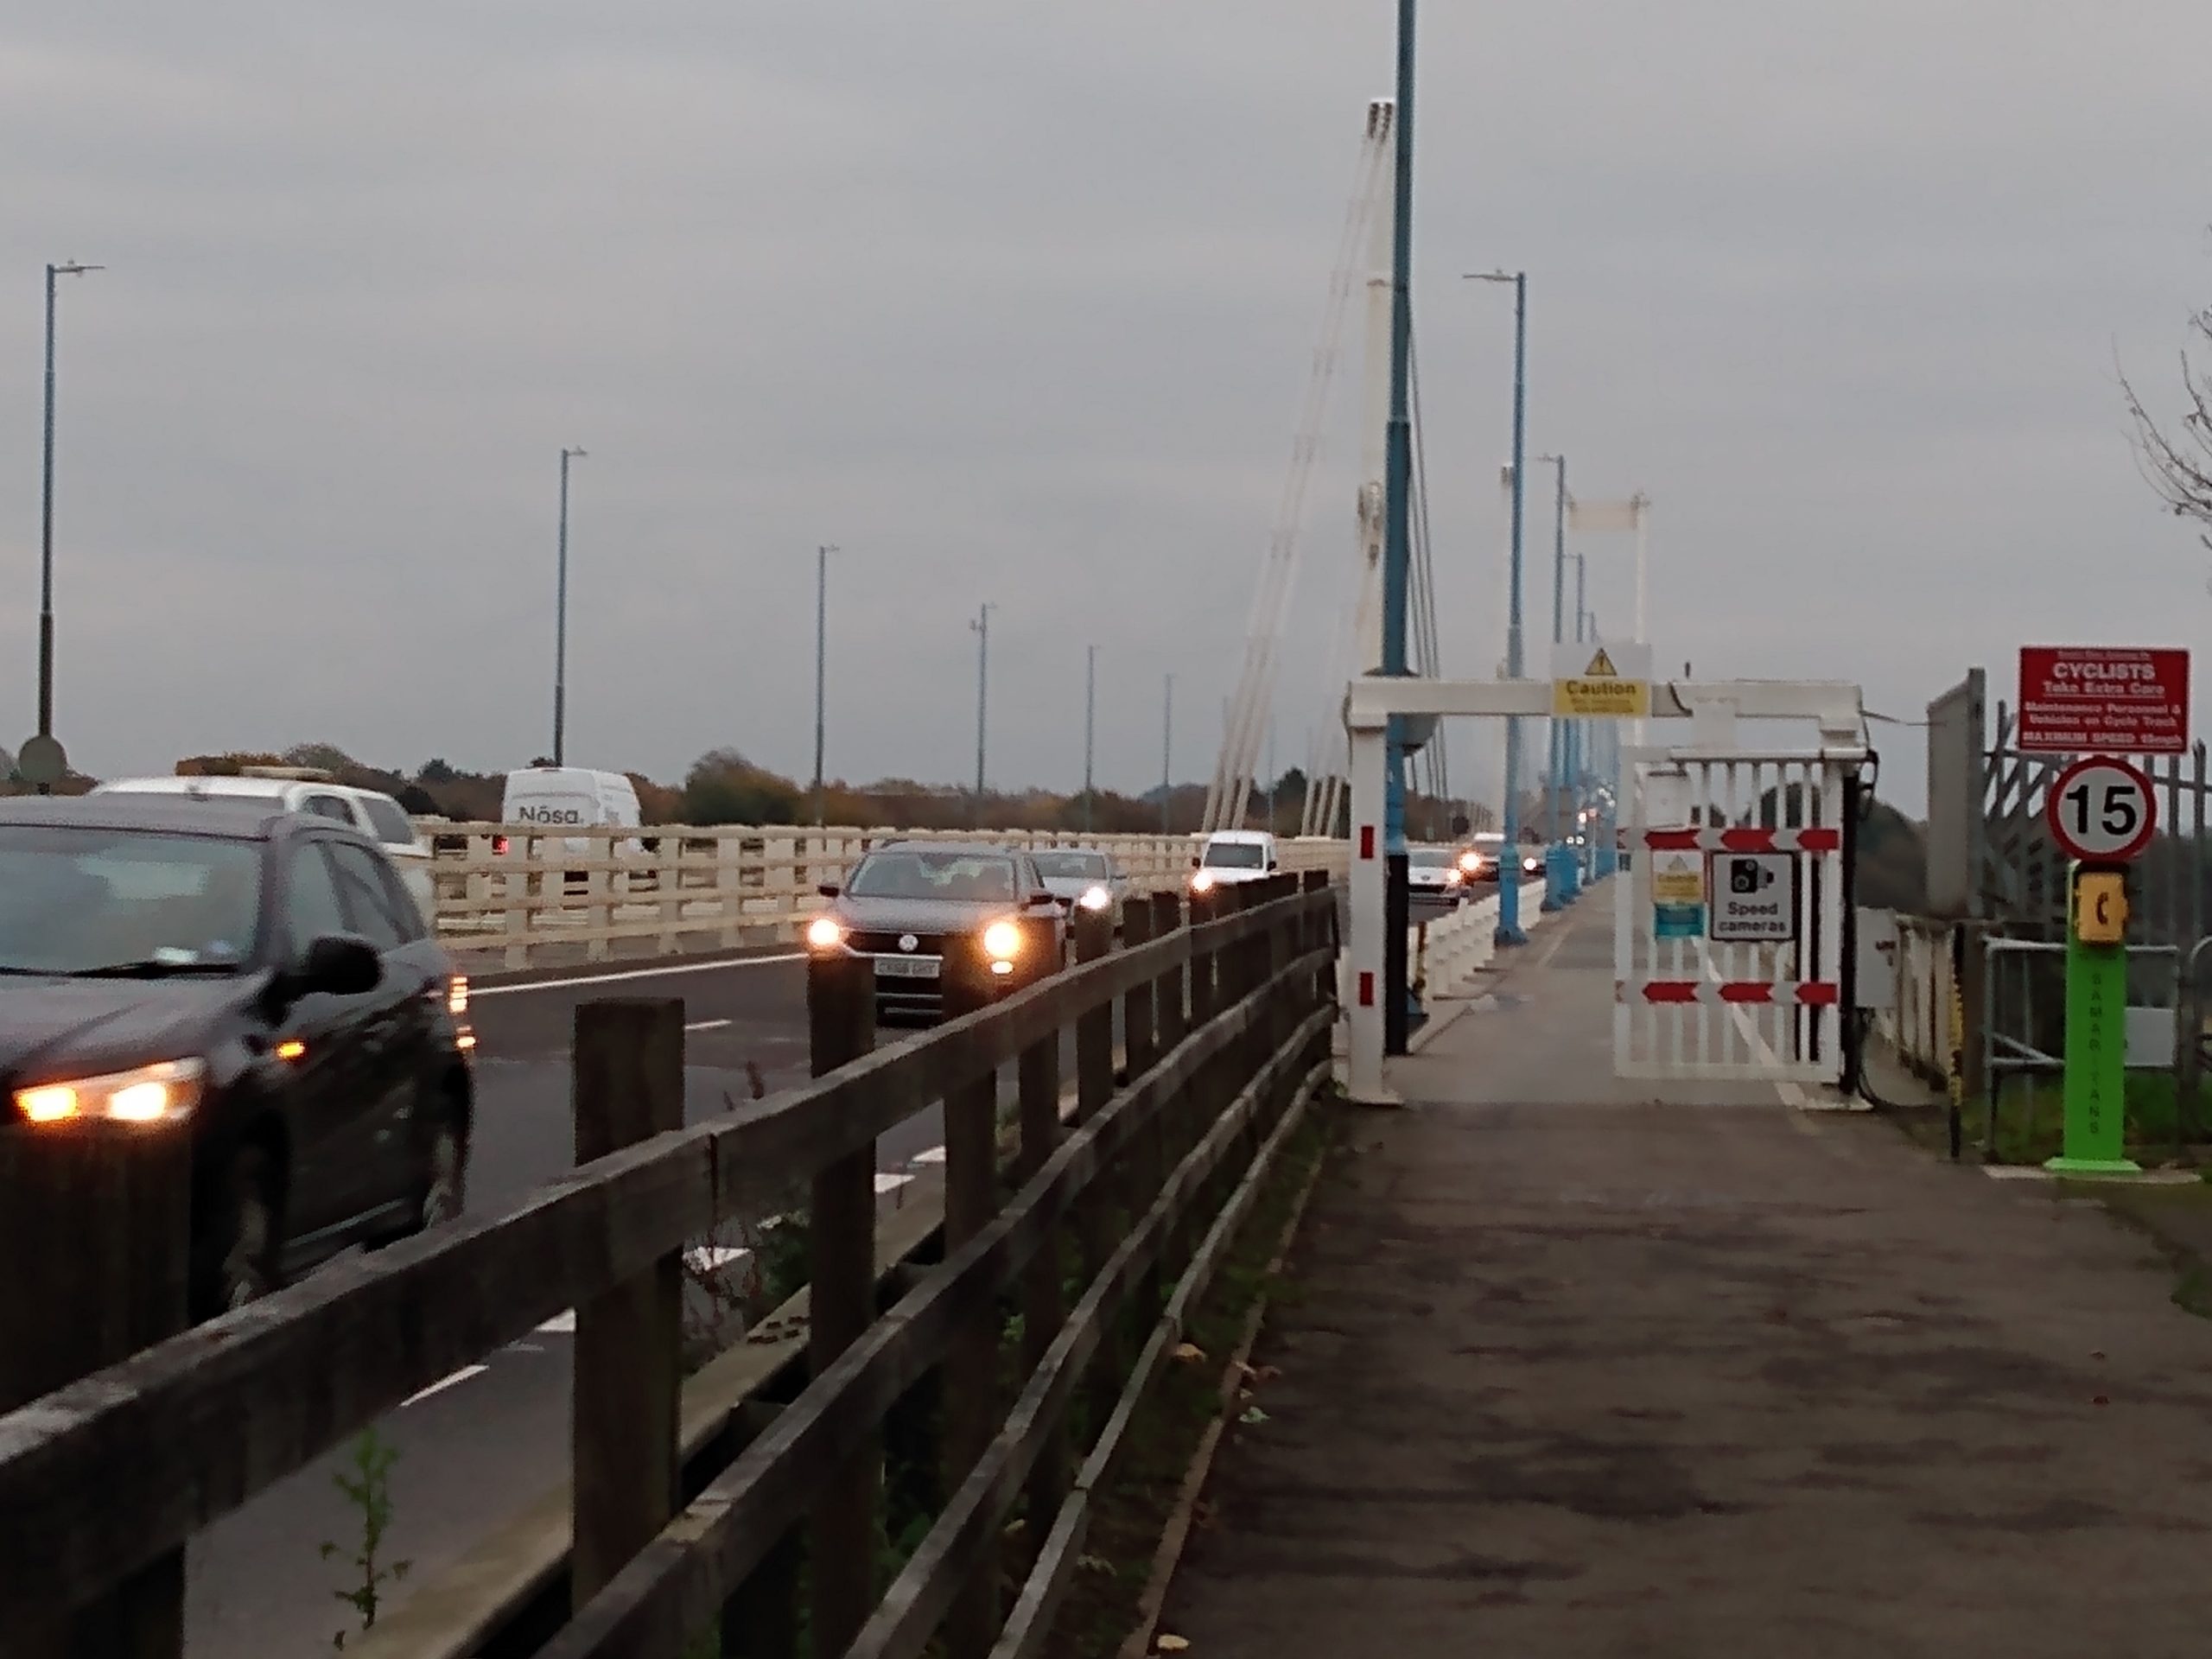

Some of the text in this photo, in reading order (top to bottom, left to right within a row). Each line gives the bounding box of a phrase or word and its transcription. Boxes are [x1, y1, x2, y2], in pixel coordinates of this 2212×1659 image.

[2053, 663, 2155, 679] CYCLISTS
[1566, 680, 1636, 695] Caution
[2044, 681, 2165, 694] Take Extra Care
[2066, 785, 2137, 836] 15
[1727, 901, 1778, 918] Speed
[1718, 921, 1787, 932] cameras
[2088, 972, 2102, 1135] SAMARITANS
